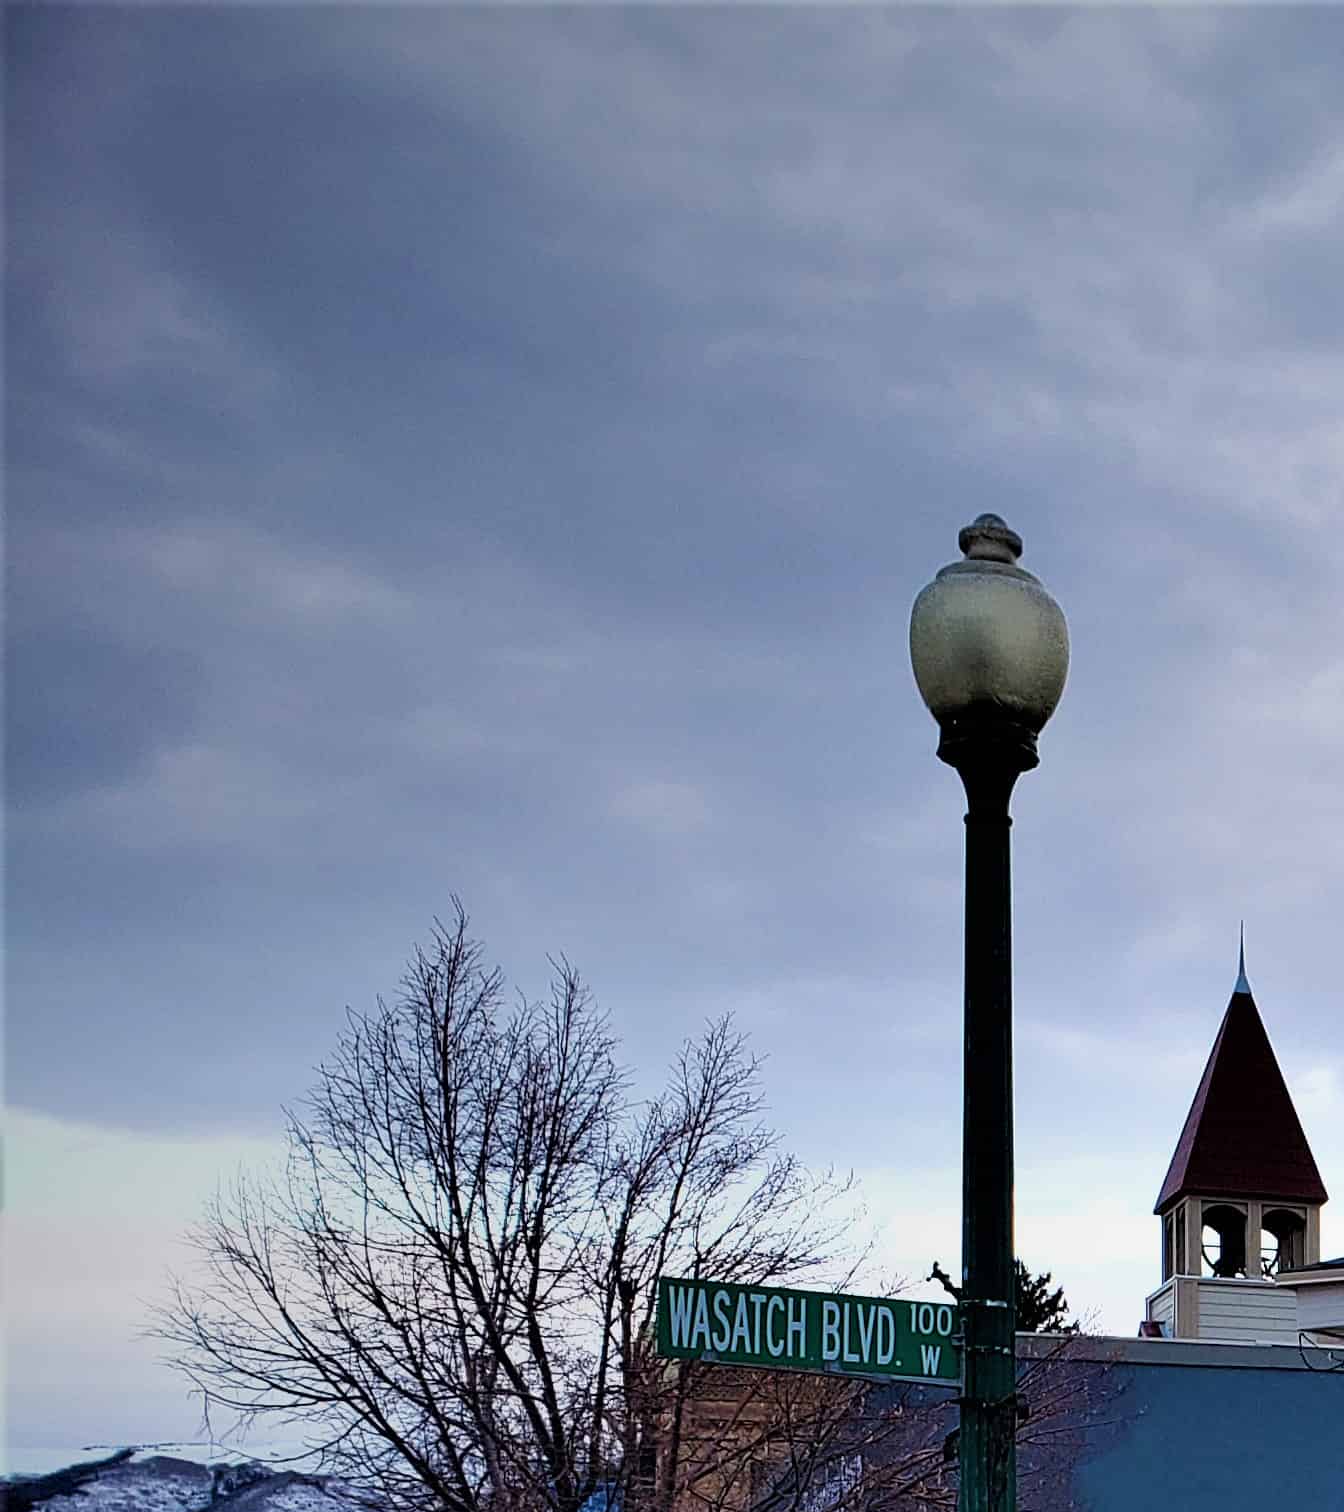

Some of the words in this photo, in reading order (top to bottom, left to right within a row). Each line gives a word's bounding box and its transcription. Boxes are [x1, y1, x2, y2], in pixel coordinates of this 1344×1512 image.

[669, 1286, 806, 1358] WASATCH
[822, 1301, 902, 1367] BLVD.
[910, 1303, 953, 1337] 100
[921, 1344, 941, 1377] W
